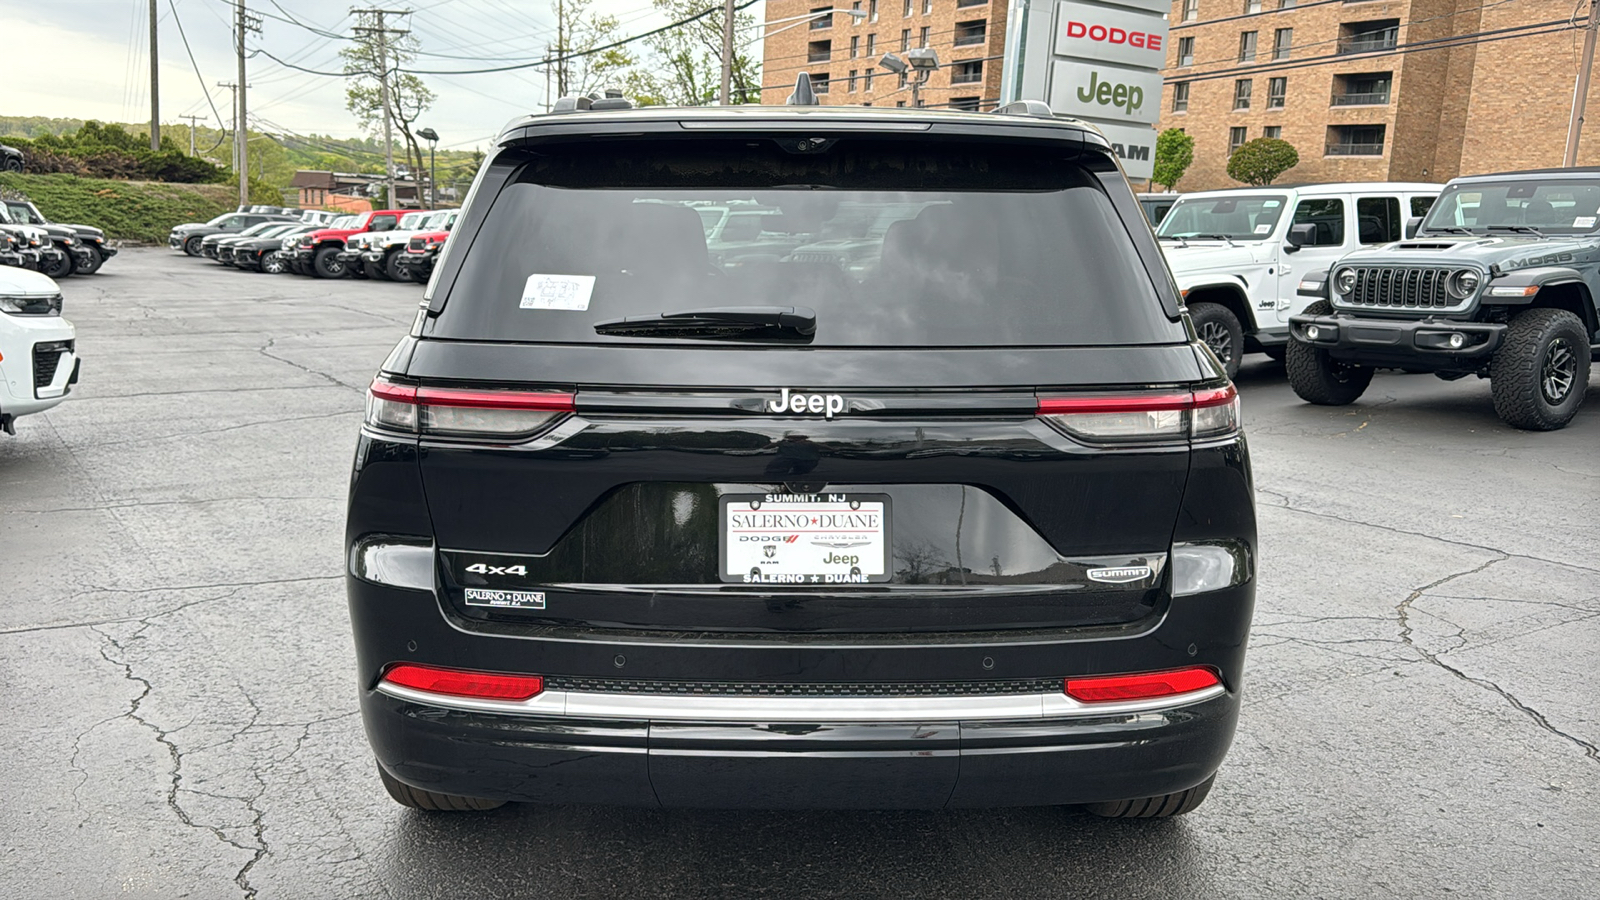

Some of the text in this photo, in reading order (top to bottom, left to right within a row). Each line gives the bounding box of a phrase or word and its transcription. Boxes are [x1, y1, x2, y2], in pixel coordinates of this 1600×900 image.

[1067, 21, 1162, 51] DODGE
[1077, 71, 1143, 115] Jeep
[1111, 143, 1149, 161] AM
[770, 388, 843, 418] Jeep
[829, 494, 846, 502] NJ
[732, 514, 879, 528] SALERNO DUANE
[823, 552, 859, 566] Jeep
[465, 563, 528, 576] 4x4
[743, 574, 869, 583] SALERNO DUANE
[467, 591, 543, 603] SALERNO DUANE
